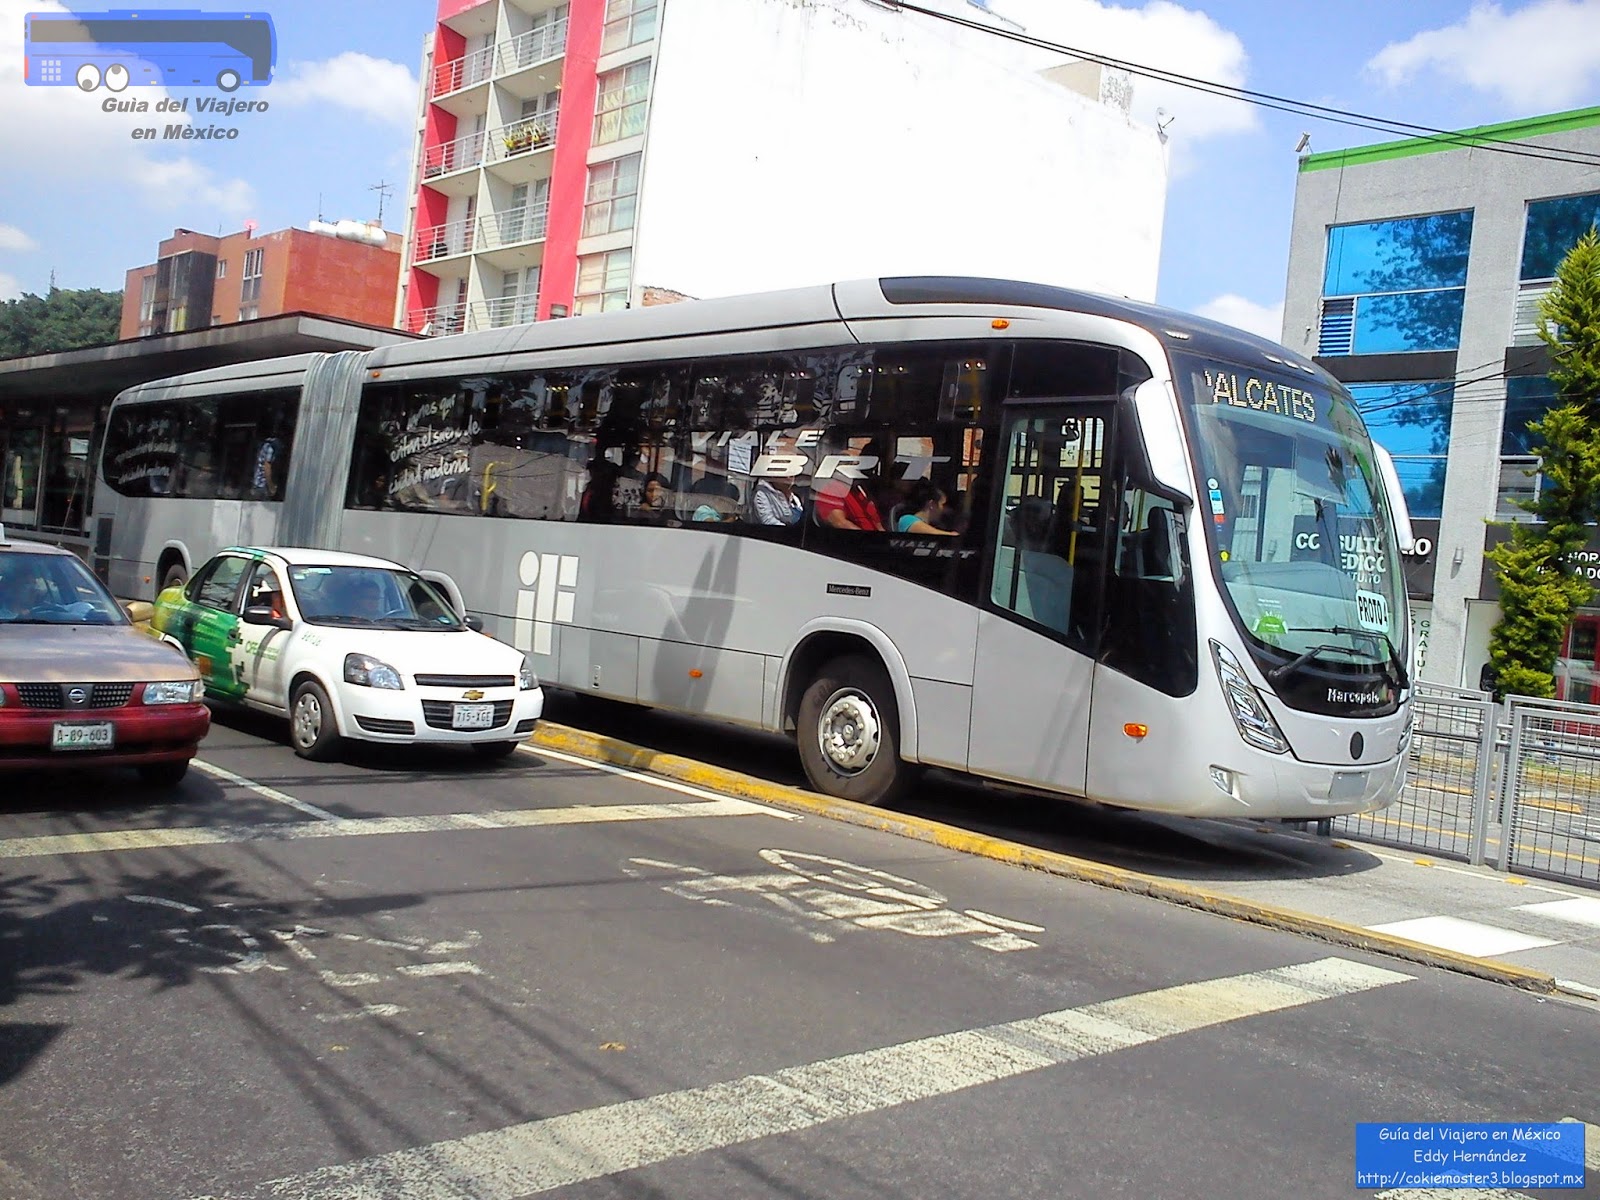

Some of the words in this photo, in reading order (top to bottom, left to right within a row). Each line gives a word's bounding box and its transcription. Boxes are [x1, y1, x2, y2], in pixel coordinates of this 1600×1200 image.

[690, 430, 826, 447] VIALE
[750, 455, 952, 480] BRT
[828, 584, 870, 596] Mercedes-Benz
[1357, 595, 1382, 626] PROTO
[57, 729, 108, 742] A-89-603
